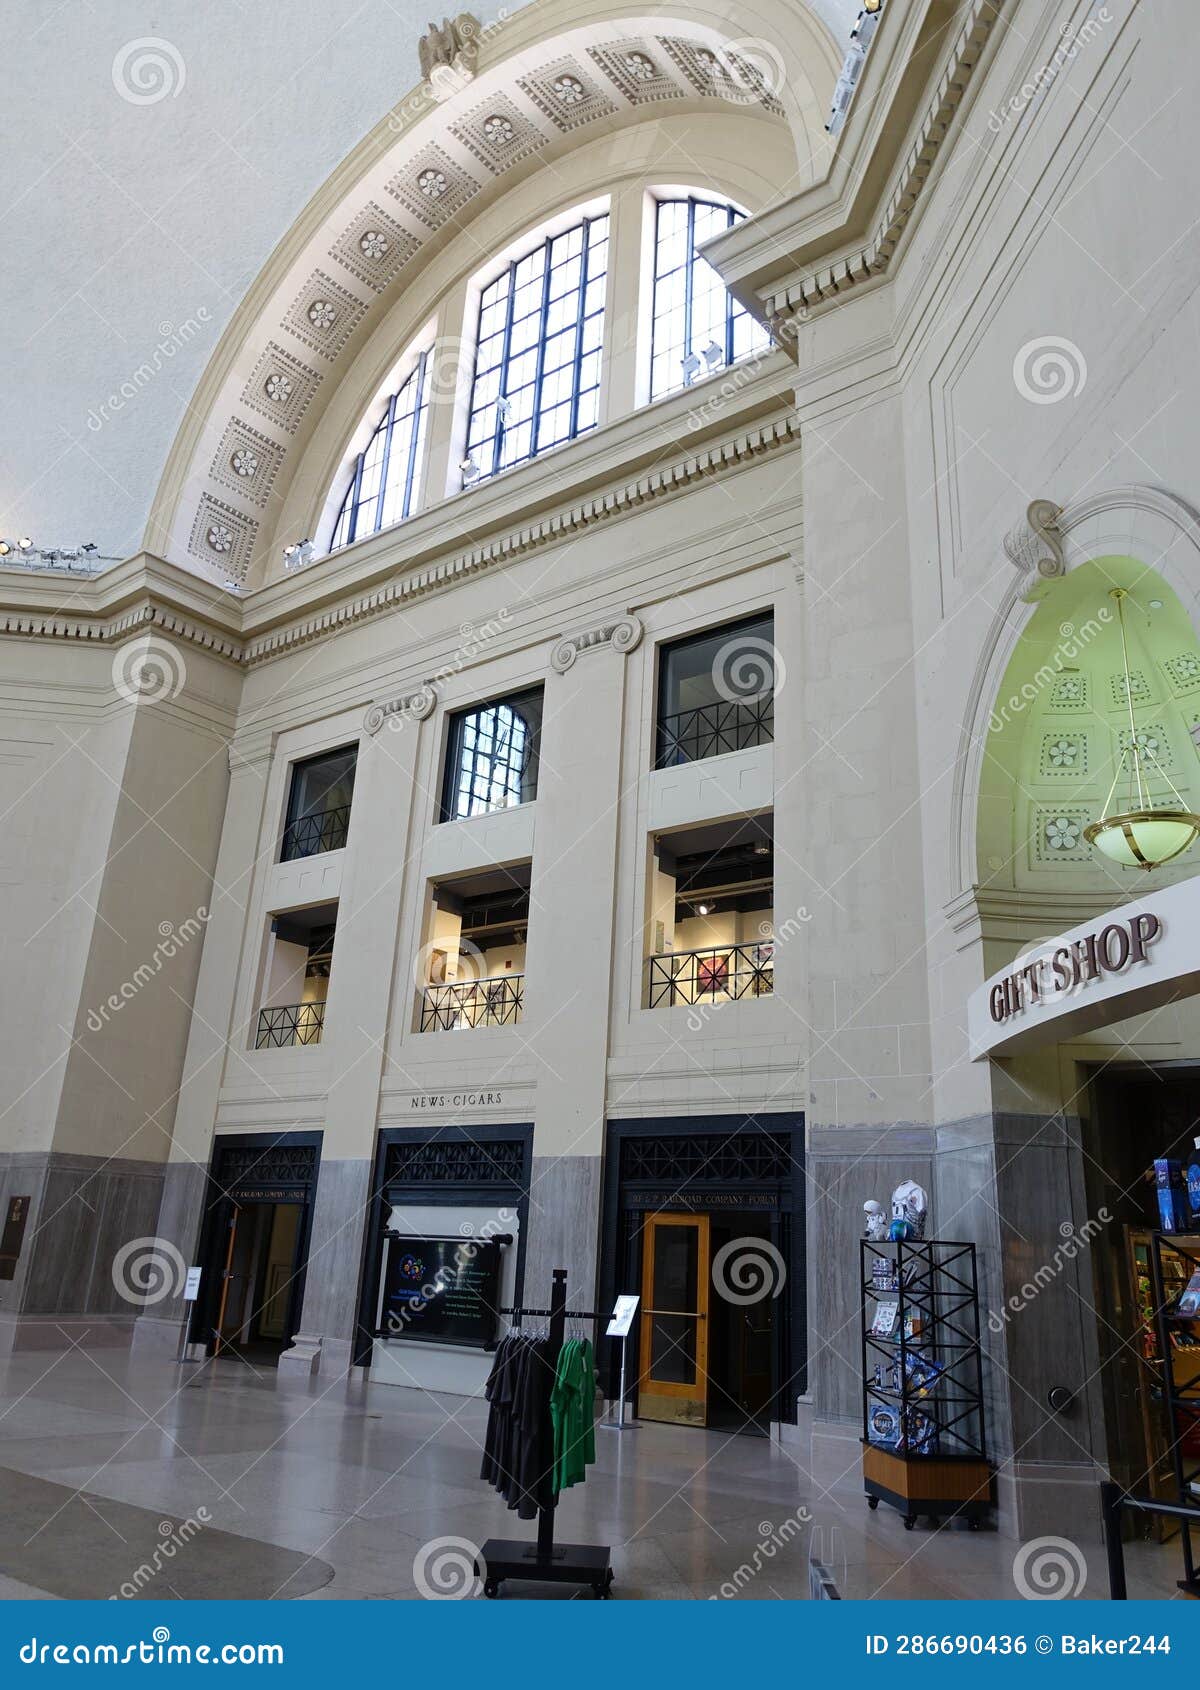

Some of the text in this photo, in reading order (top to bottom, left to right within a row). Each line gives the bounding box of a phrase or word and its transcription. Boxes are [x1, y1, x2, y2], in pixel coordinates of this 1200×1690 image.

[989, 913, 1162, 1023] GIFT SHOP
[705, 1194, 744, 1204] COMPANY
